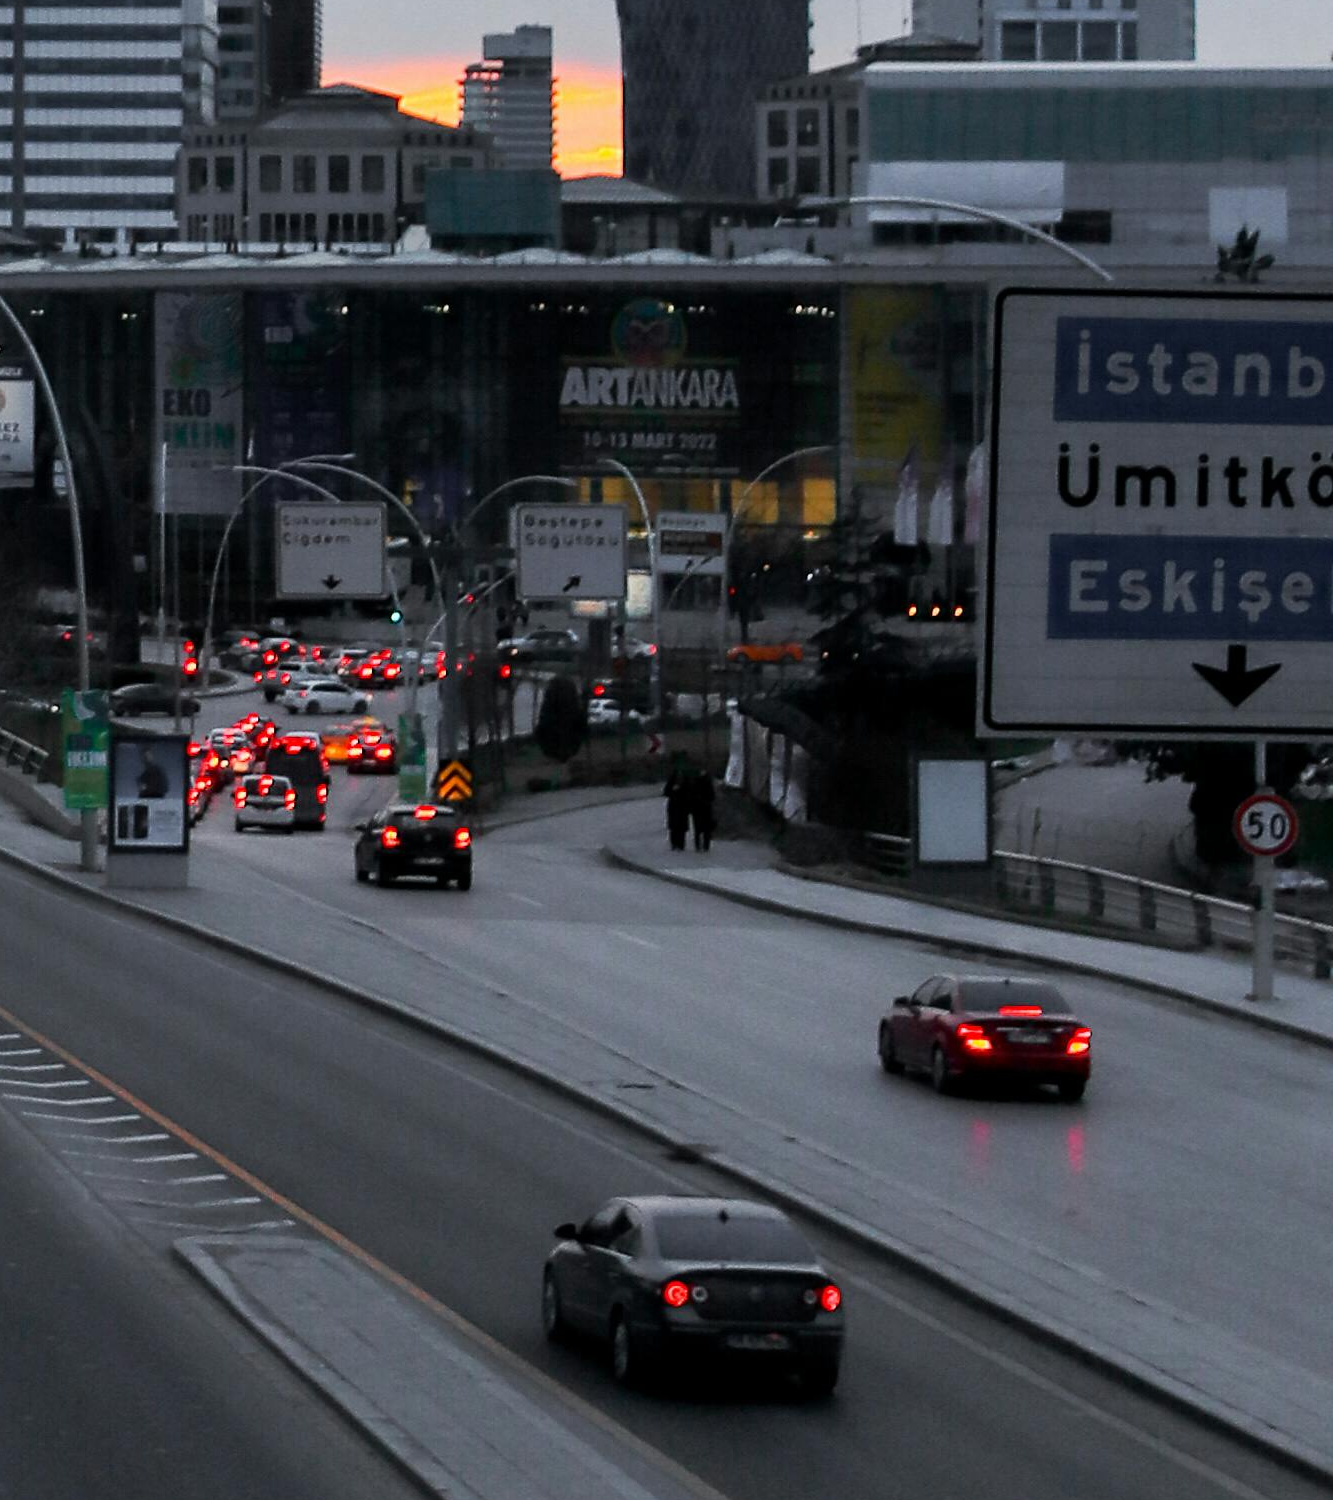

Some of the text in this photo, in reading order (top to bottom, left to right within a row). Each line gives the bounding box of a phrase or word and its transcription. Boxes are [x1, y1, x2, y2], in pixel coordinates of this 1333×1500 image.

[1076, 328, 1326, 399] İstanb
[162, 388, 212, 417] EKO
[558, 366, 741, 408] ARTANKARA
[1068, 557, 1333, 623] Eskişe
[1249, 811, 1286, 840] 50
